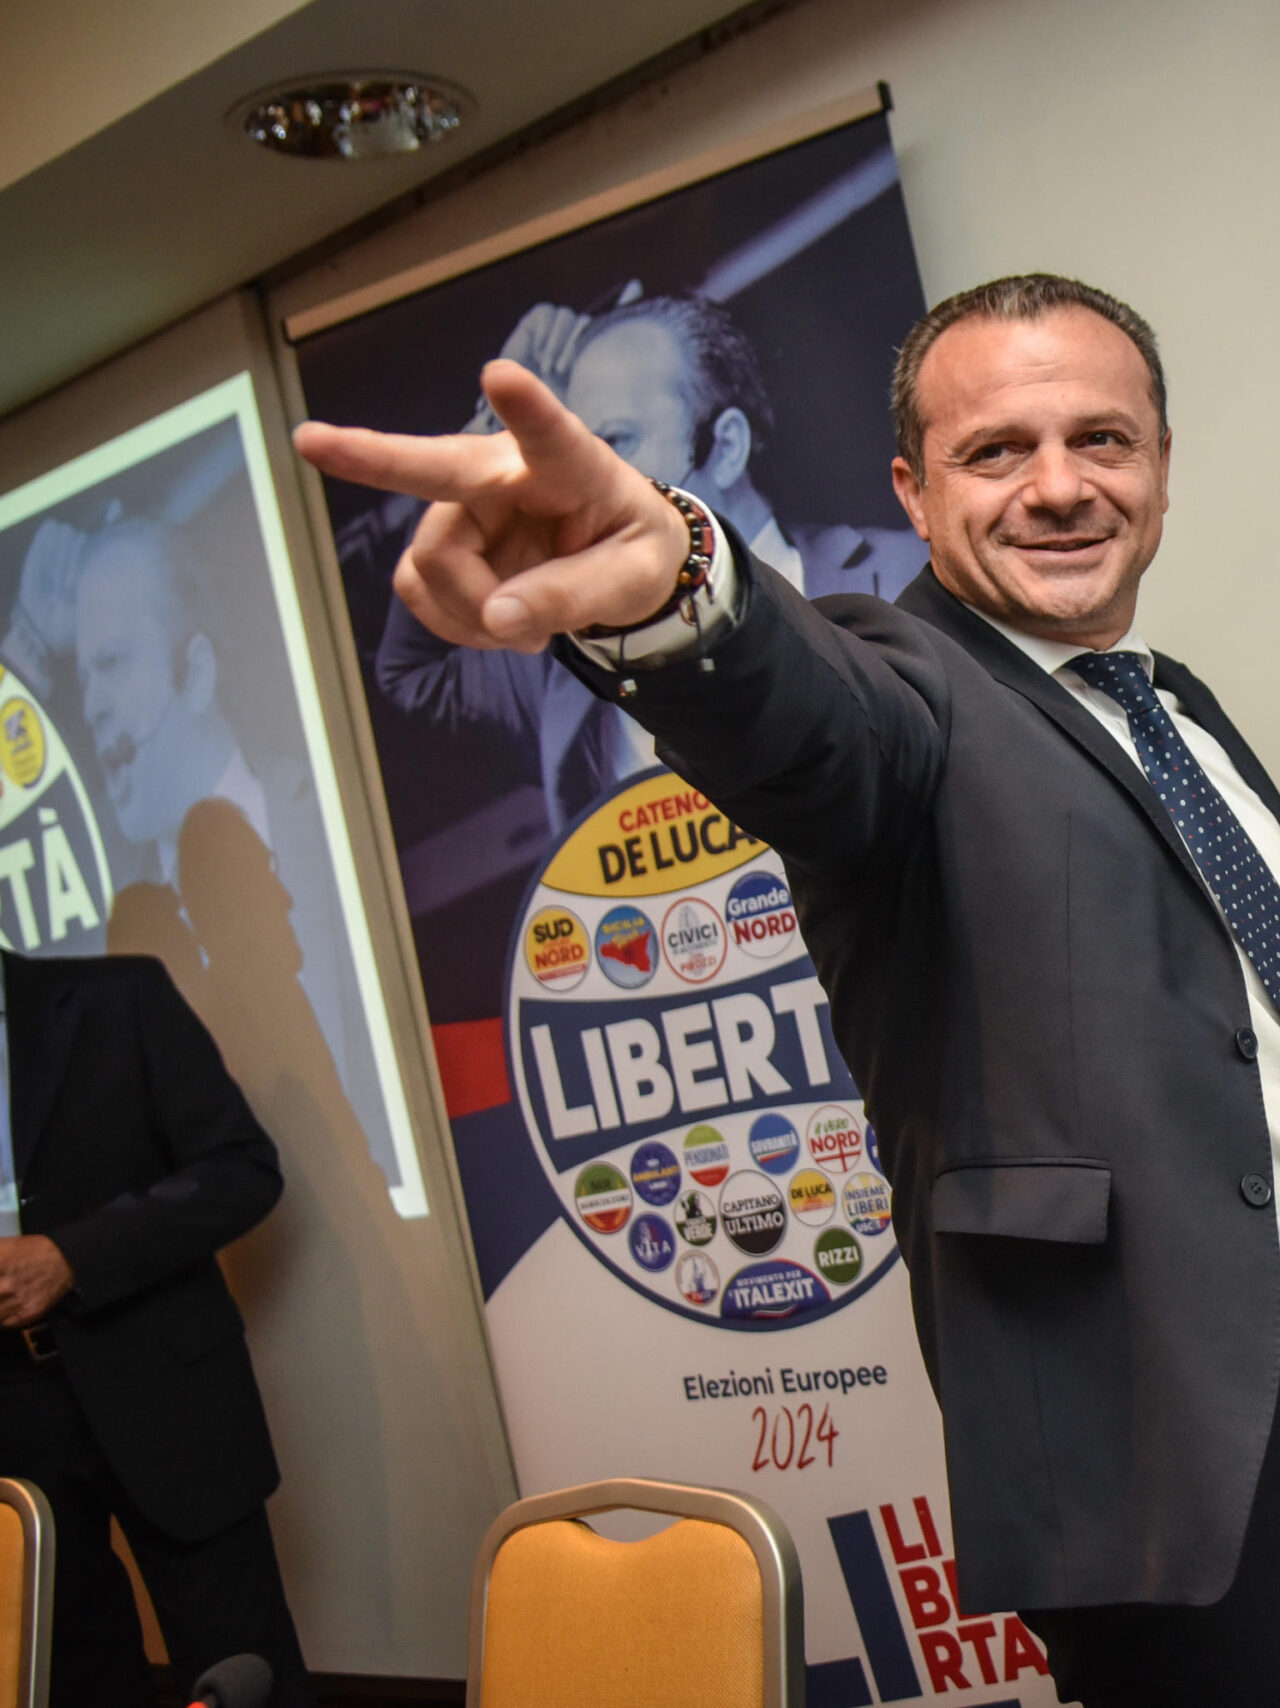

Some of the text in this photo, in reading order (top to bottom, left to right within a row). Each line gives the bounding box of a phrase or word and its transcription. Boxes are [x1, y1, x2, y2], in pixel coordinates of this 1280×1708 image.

[598, 813, 758, 884] DE LUCA
[727, 886, 789, 917] Grande
[533, 917, 573, 944] SUD
[668, 922, 718, 948] CIVICI
[733, 910, 796, 946] NORD
[534, 943, 585, 969] NORD
[530, 977, 854, 1141] LIBERT
[810, 1130, 860, 1154] NORD
[804, 1183, 833, 1197] LUCA
[723, 1194, 779, 1213] CAPITANO
[847, 1198, 890, 1217] LIBERI
[725, 1212, 784, 1236] ULTIMO
[818, 1245, 859, 1268] RIZZI
[683, 1362, 888, 1401] Elezioni Europee
[752, 1402, 839, 1472] 2024
[879, 1495, 943, 1565] LI
